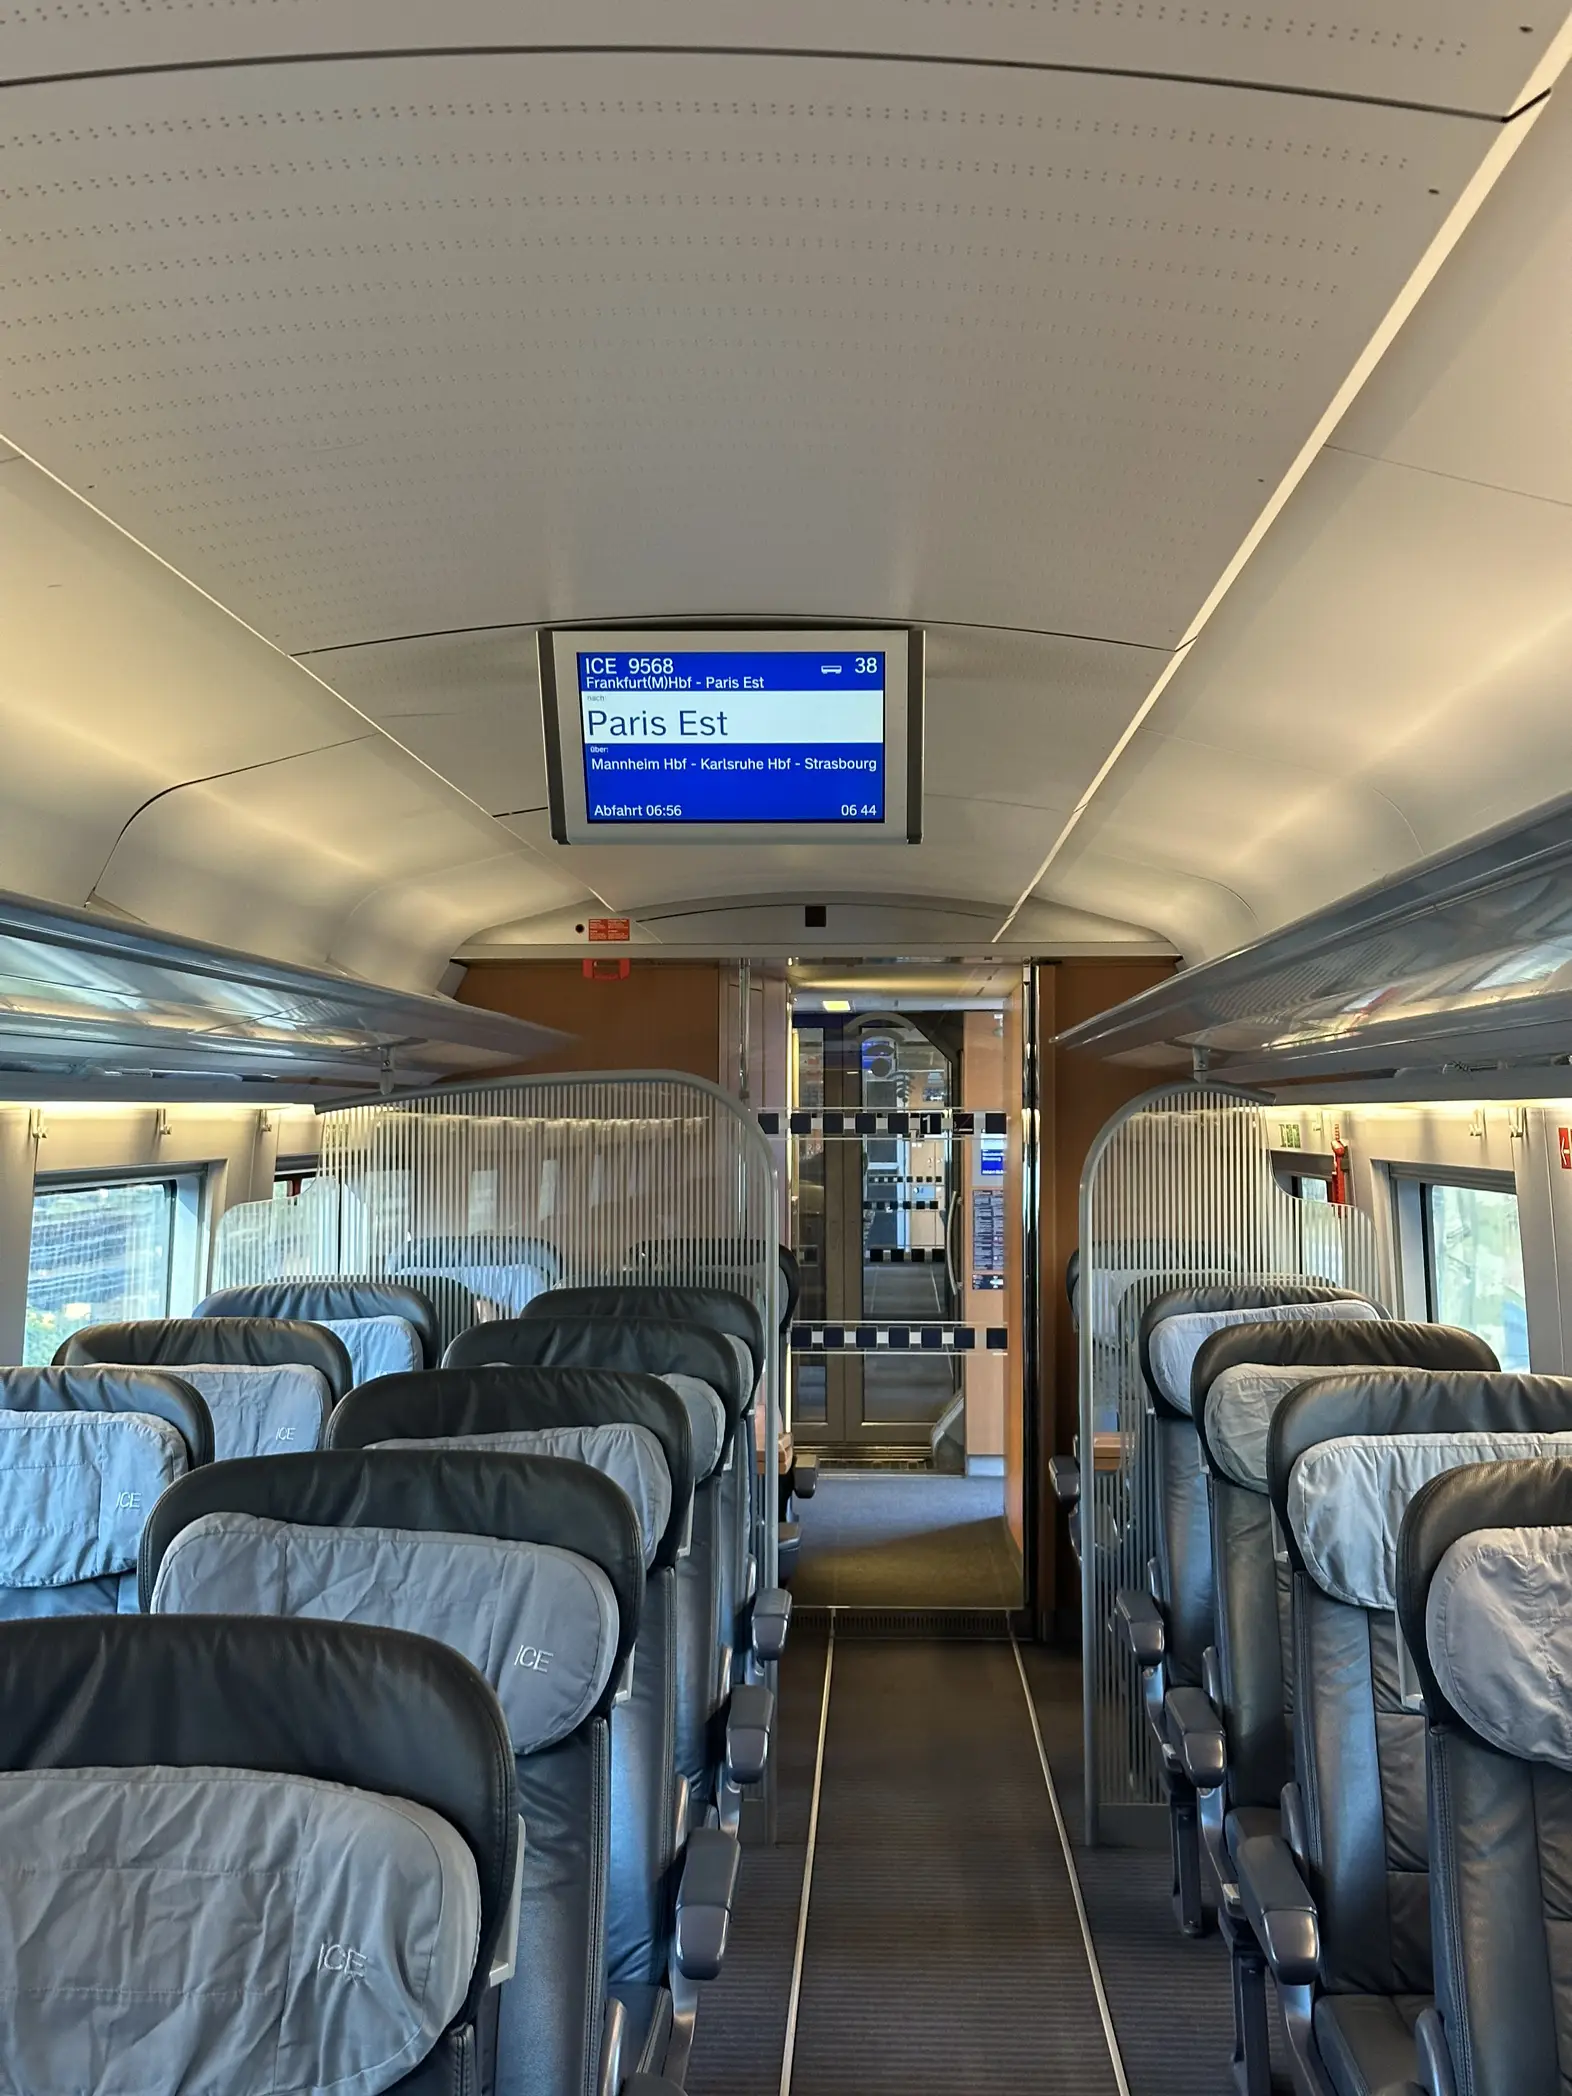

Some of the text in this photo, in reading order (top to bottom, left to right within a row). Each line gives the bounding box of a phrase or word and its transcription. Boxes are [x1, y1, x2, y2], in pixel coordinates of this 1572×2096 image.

[585, 657, 674, 675] ICE 9568
[854, 657, 878, 674] 38
[586, 675, 692, 690] Frankfurt(M)Hbf
[706, 676, 740, 689] Paris
[743, 676, 765, 689] Est
[588, 710, 728, 736] Paris Est
[591, 758, 660, 770] Mannheim
[663, 758, 687, 770] Hbf
[700, 758, 764, 770] Karlsruhe
[767, 757, 792, 770] Hbf
[804, 757, 877, 772] Strasbourg
[594, 804, 682, 817] Abfahrt 06:56
[922, 1114, 931, 1134] 1
[275, 1426, 297, 1441] ICE
[115, 1491, 142, 1508] ICE
[513, 1644, 554, 1673] ICE
[317, 1943, 367, 1978] ICE
